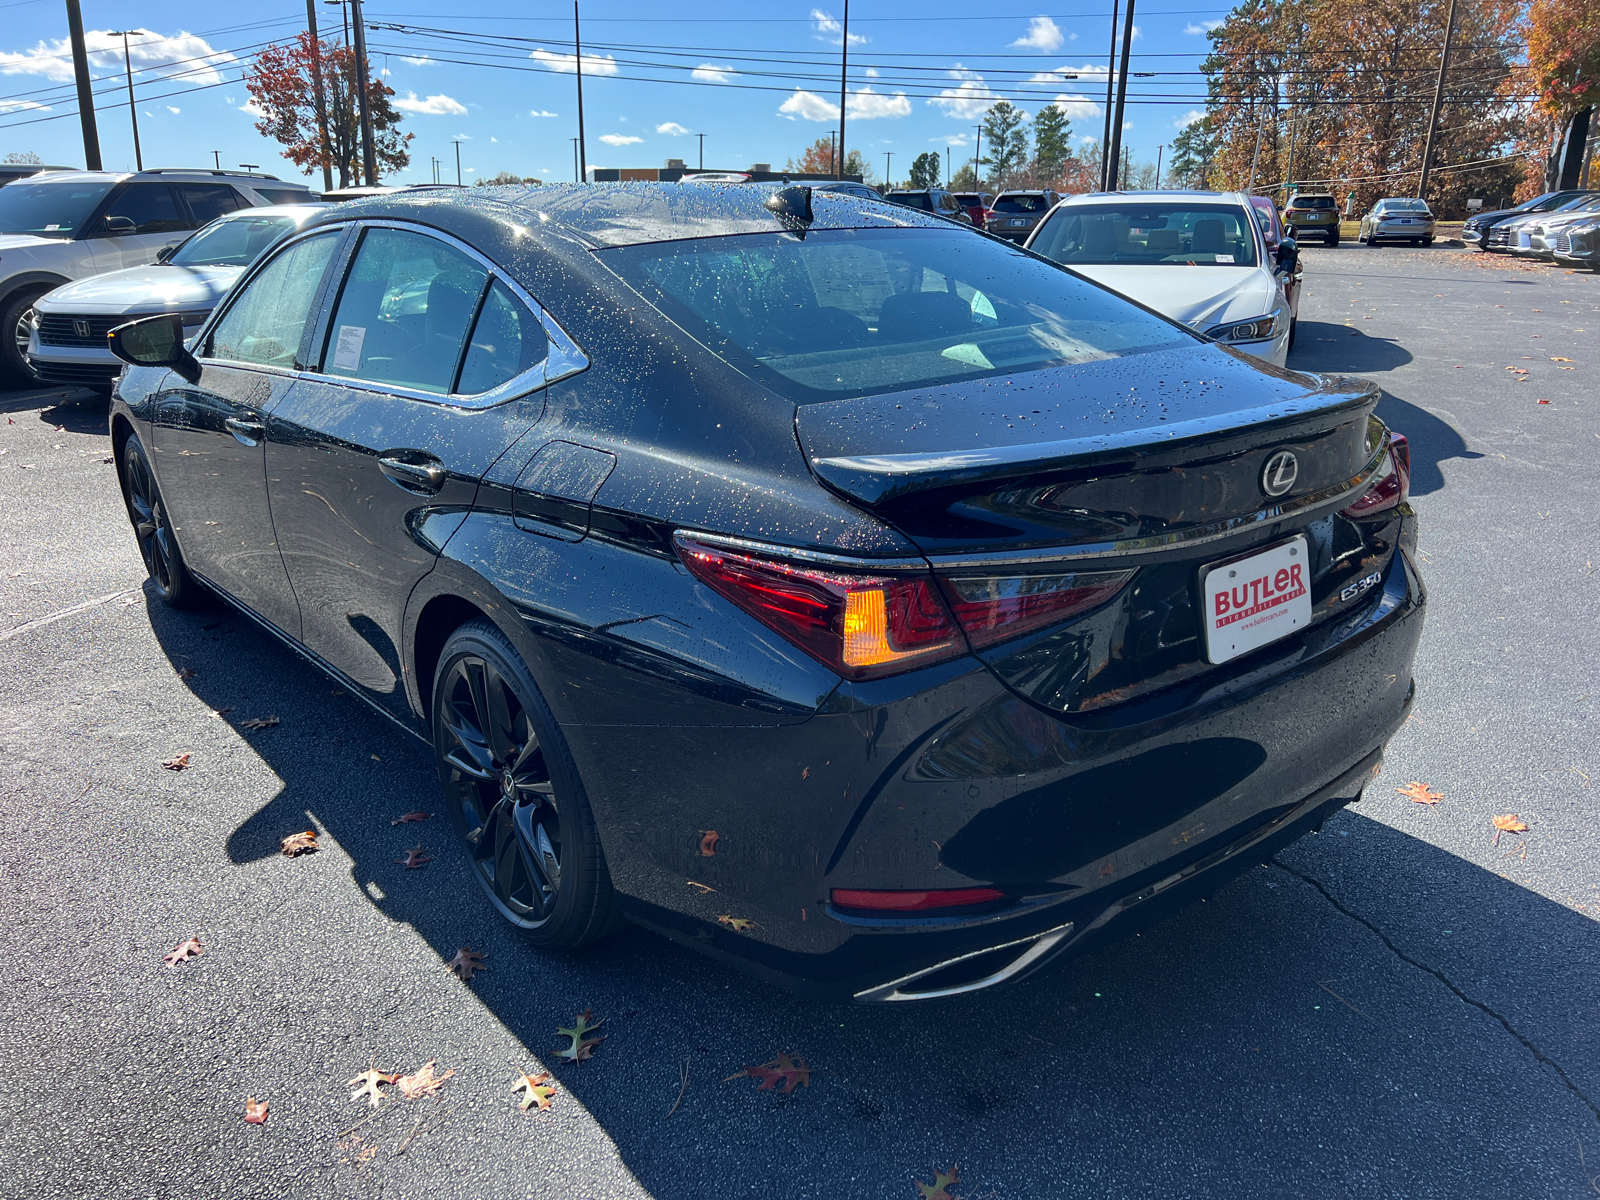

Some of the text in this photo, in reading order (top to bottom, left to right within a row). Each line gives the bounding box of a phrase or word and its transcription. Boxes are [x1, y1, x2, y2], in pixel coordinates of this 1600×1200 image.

[1216, 587, 1305, 628] AUTOMOTIVE GROUP
[1241, 608, 1289, 631] www.butlercars.com
